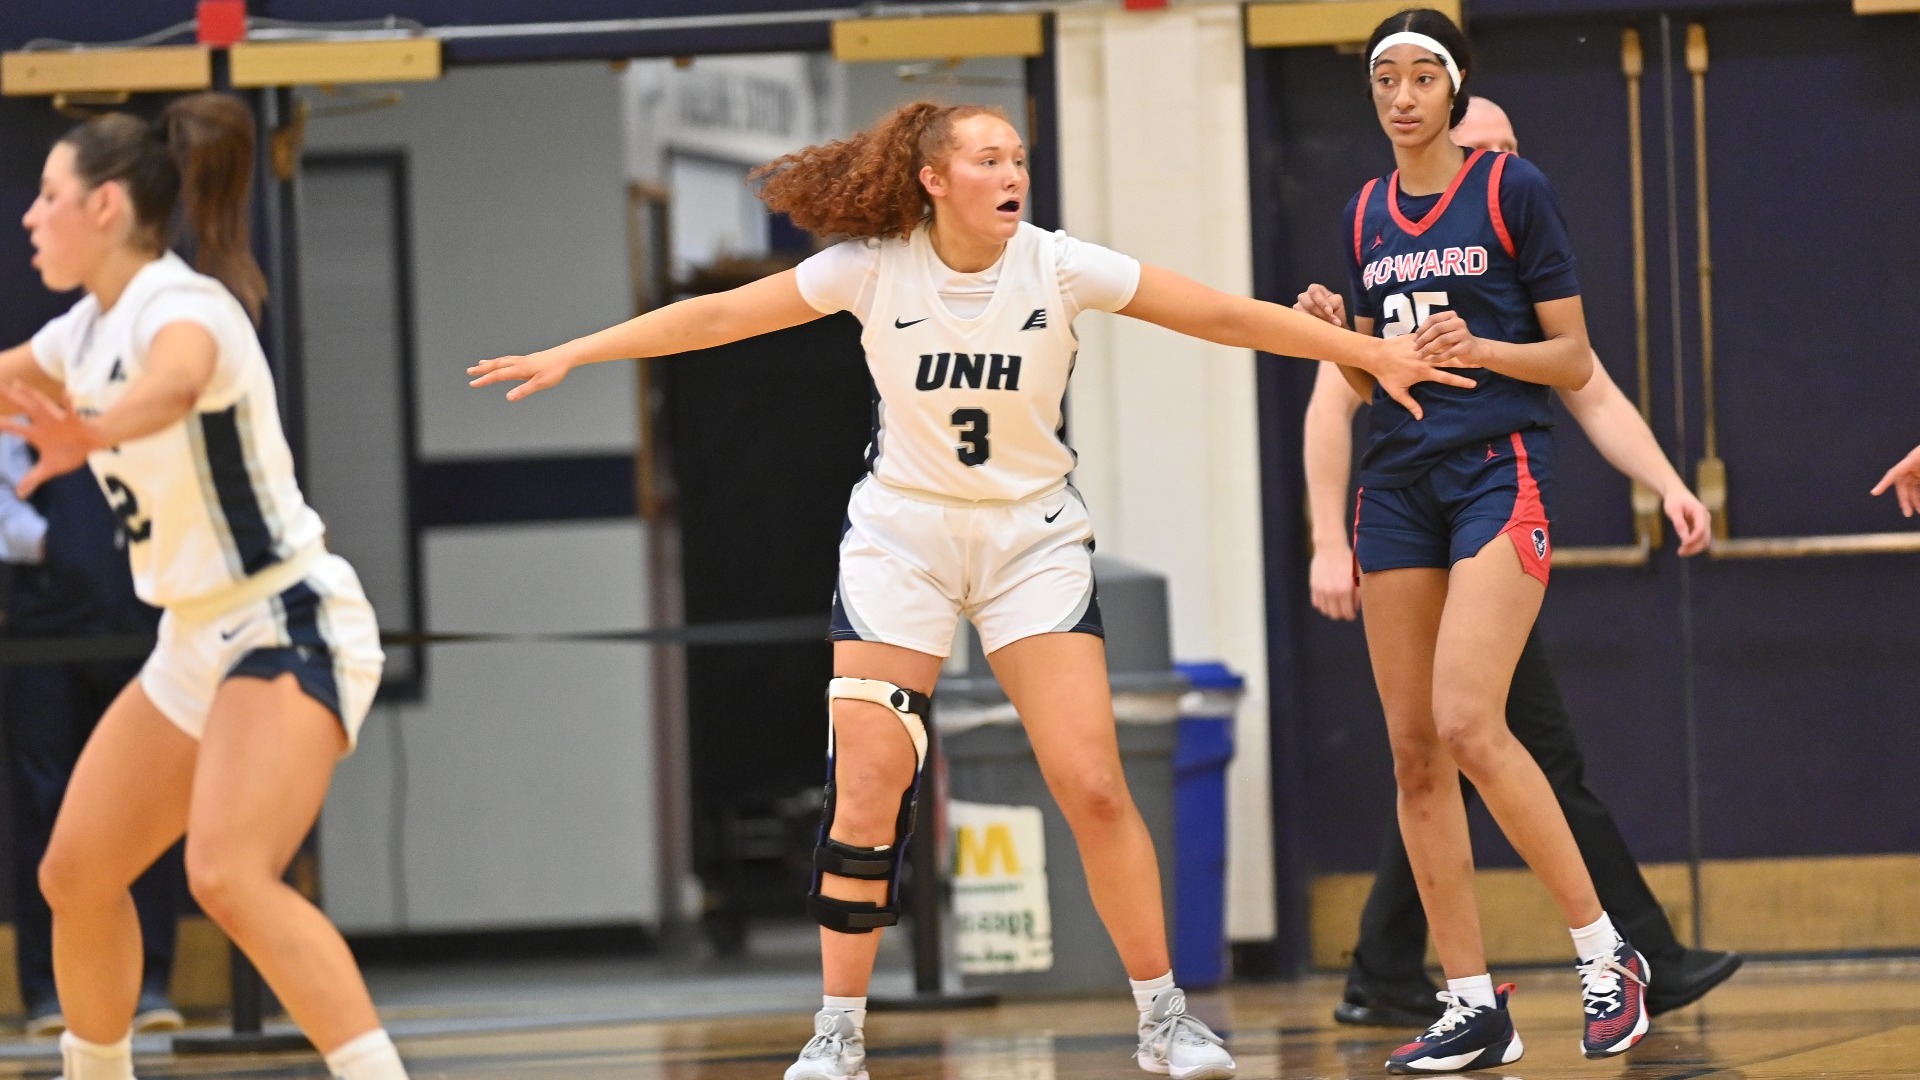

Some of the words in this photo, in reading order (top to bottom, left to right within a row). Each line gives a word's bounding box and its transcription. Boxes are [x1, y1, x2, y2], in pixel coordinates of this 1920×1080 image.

[1363, 246, 1488, 290] HOWARD
[915, 352, 1022, 391] UNH
[949, 406, 990, 467] 3
